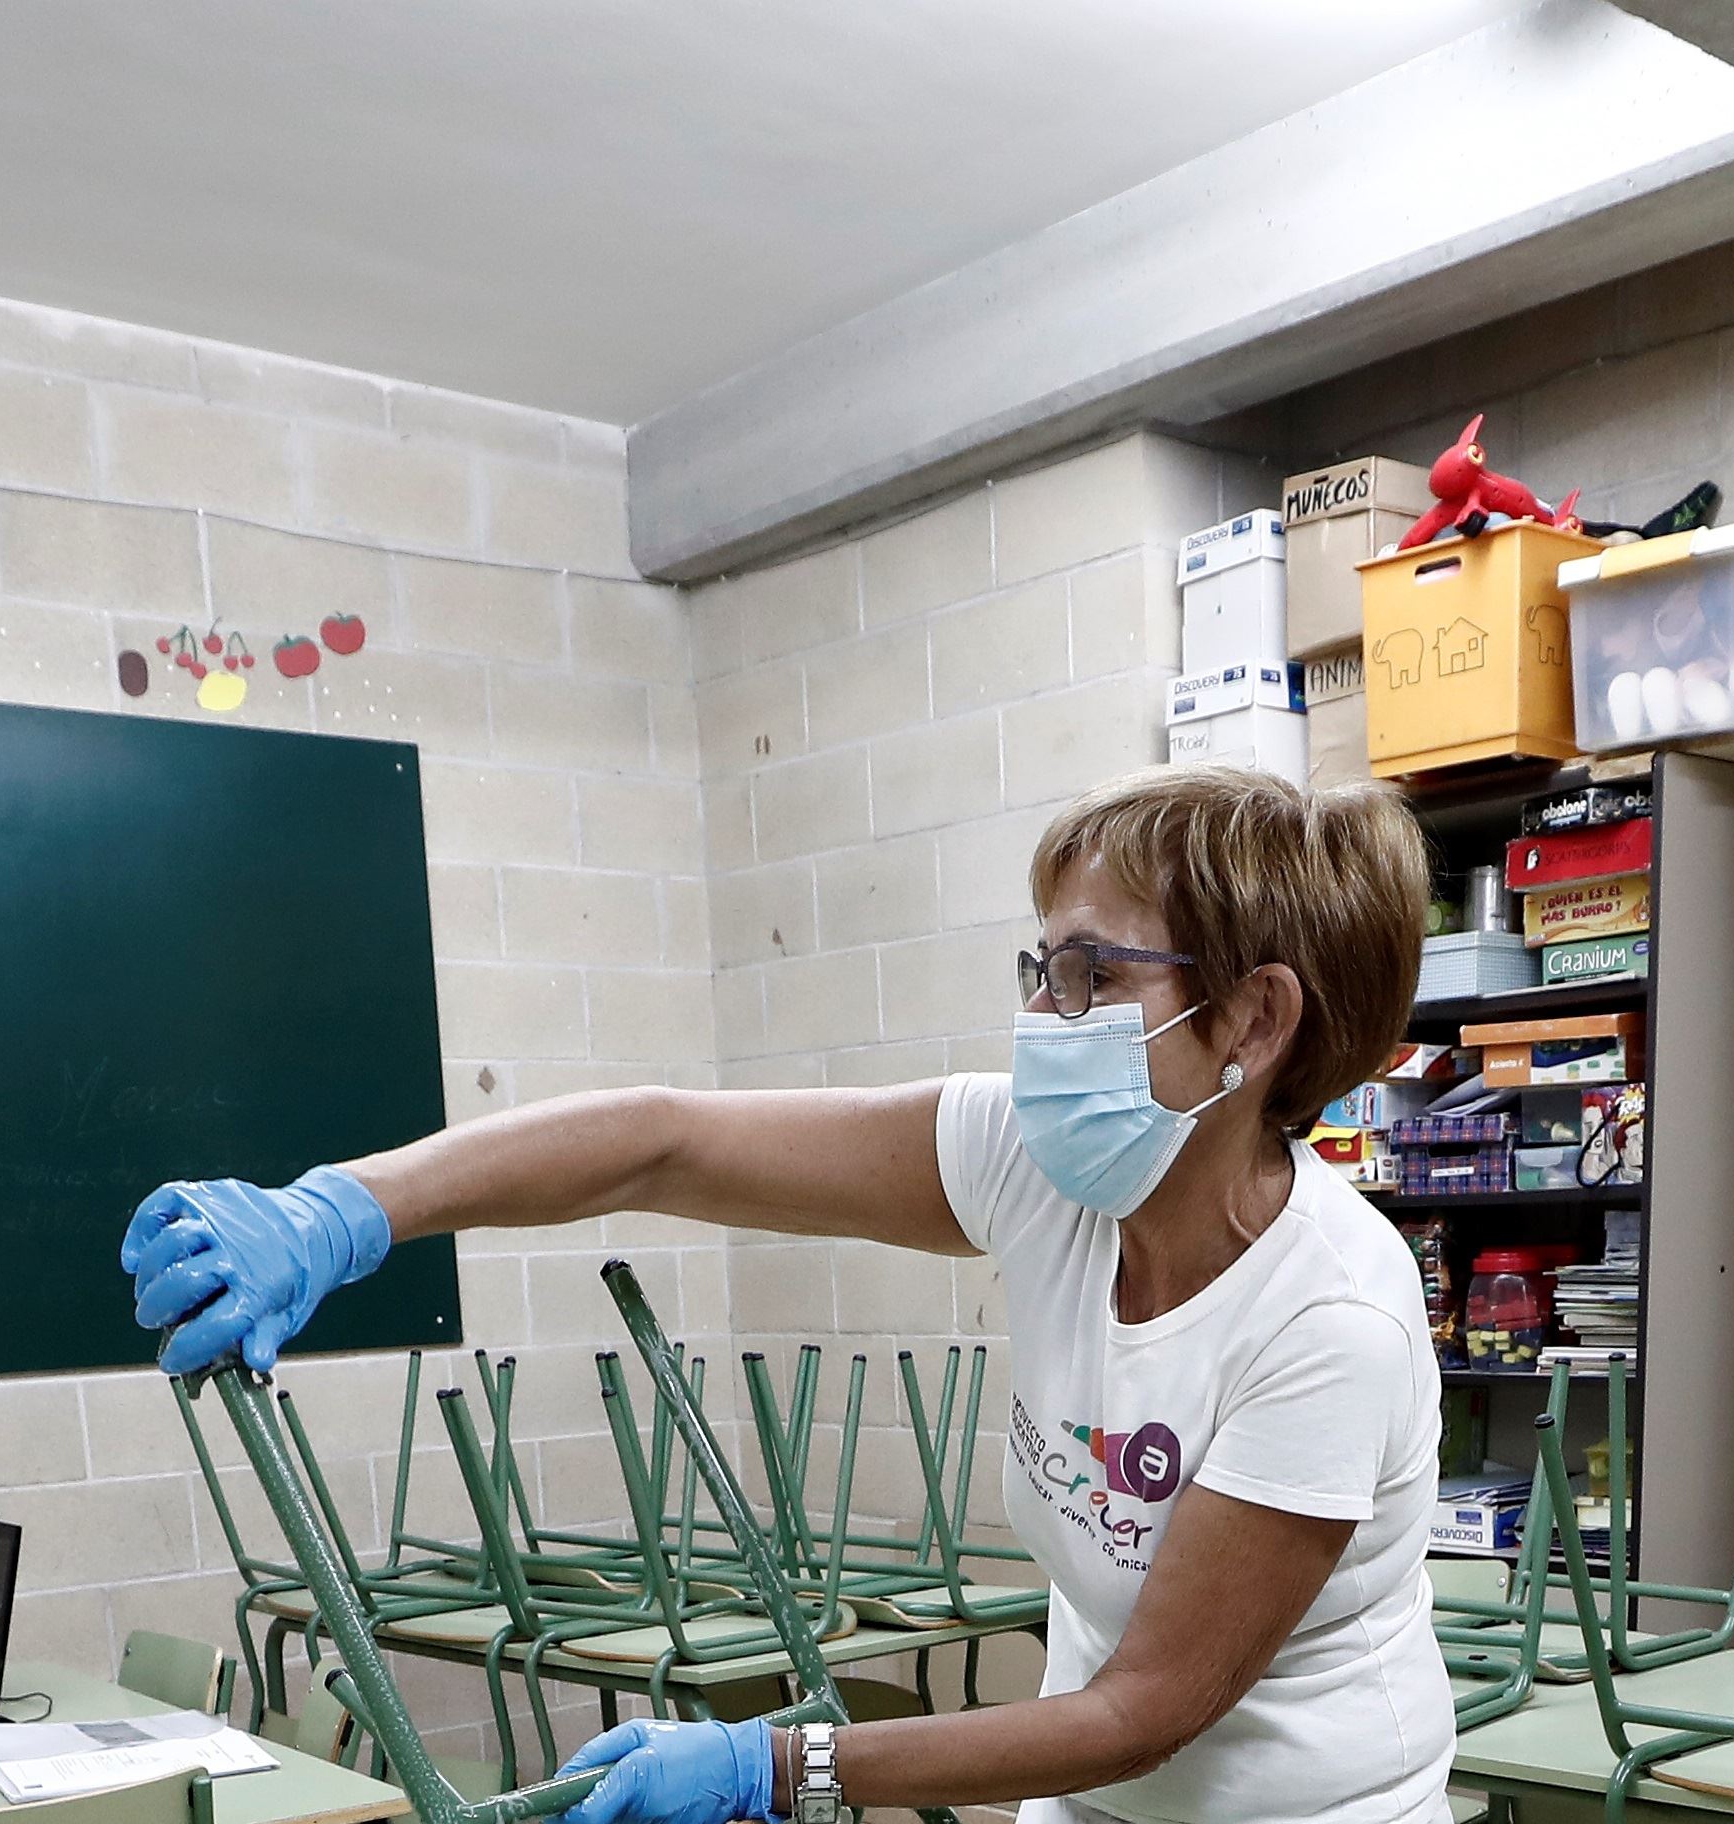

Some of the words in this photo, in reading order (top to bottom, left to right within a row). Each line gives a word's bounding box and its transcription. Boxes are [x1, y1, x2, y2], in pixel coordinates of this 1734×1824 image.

[1286, 468, 1369, 523] MUÑECOS
[1310, 656, 1365, 693] ANIM
[1541, 798, 1587, 820] abalone
